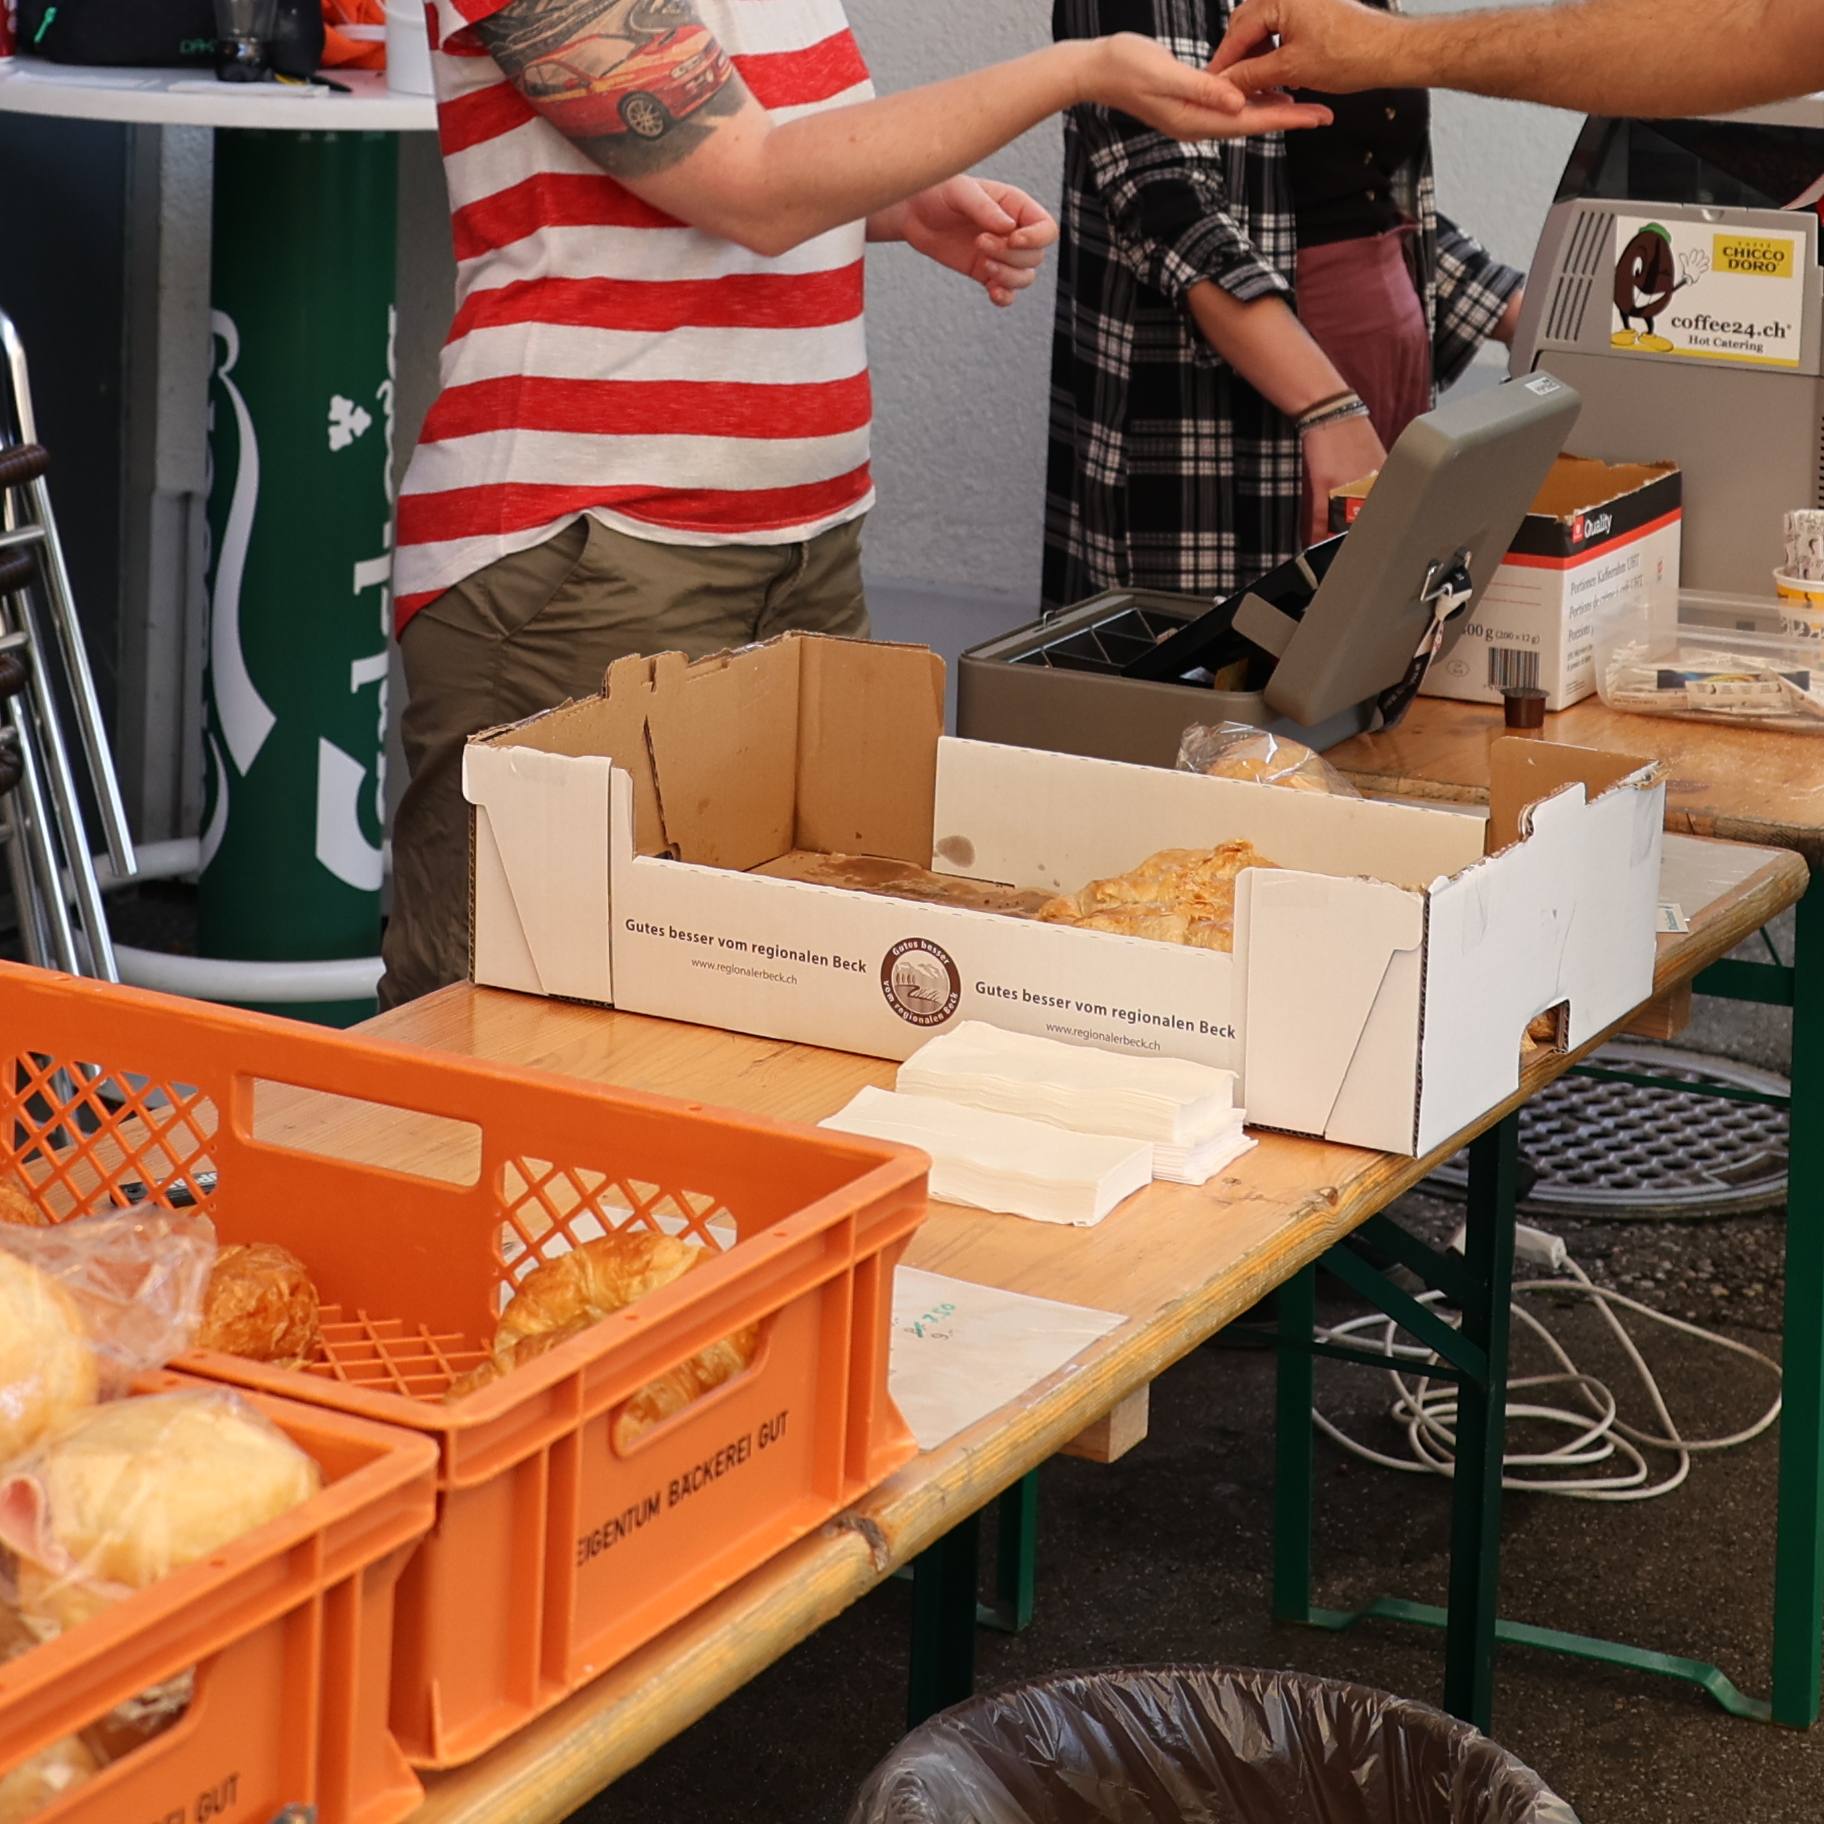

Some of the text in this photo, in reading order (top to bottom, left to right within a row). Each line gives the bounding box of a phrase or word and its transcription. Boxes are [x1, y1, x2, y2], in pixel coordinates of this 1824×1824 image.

[1722, 246, 1785, 262] CHICCO
[1728, 258, 1778, 273] D'ORO
[1671, 314, 1786, 339] coffee24.ch
[1688, 335, 1764, 353] Hot Catering
[1584, 513, 1613, 539] Quality
[1463, 624, 1484, 637] 00
[1485, 628, 1494, 642] g
[625, 918, 867, 973] Gutes besser vom regionalen Beck
[892, 940, 950, 964] Gutes besser
[691, 958, 798, 985] www.regionalerbeck.ch
[883, 980, 895, 1003] vom
[894, 1003, 944, 1024] regionalen
[975, 981, 1236, 1039] Gutes besser vom regionalen Beck
[1046, 1022, 1161, 1051] www.regionalerbeck.ch
[577, 1409, 789, 1567] EIGENTUM BÄCKEREI GUT
